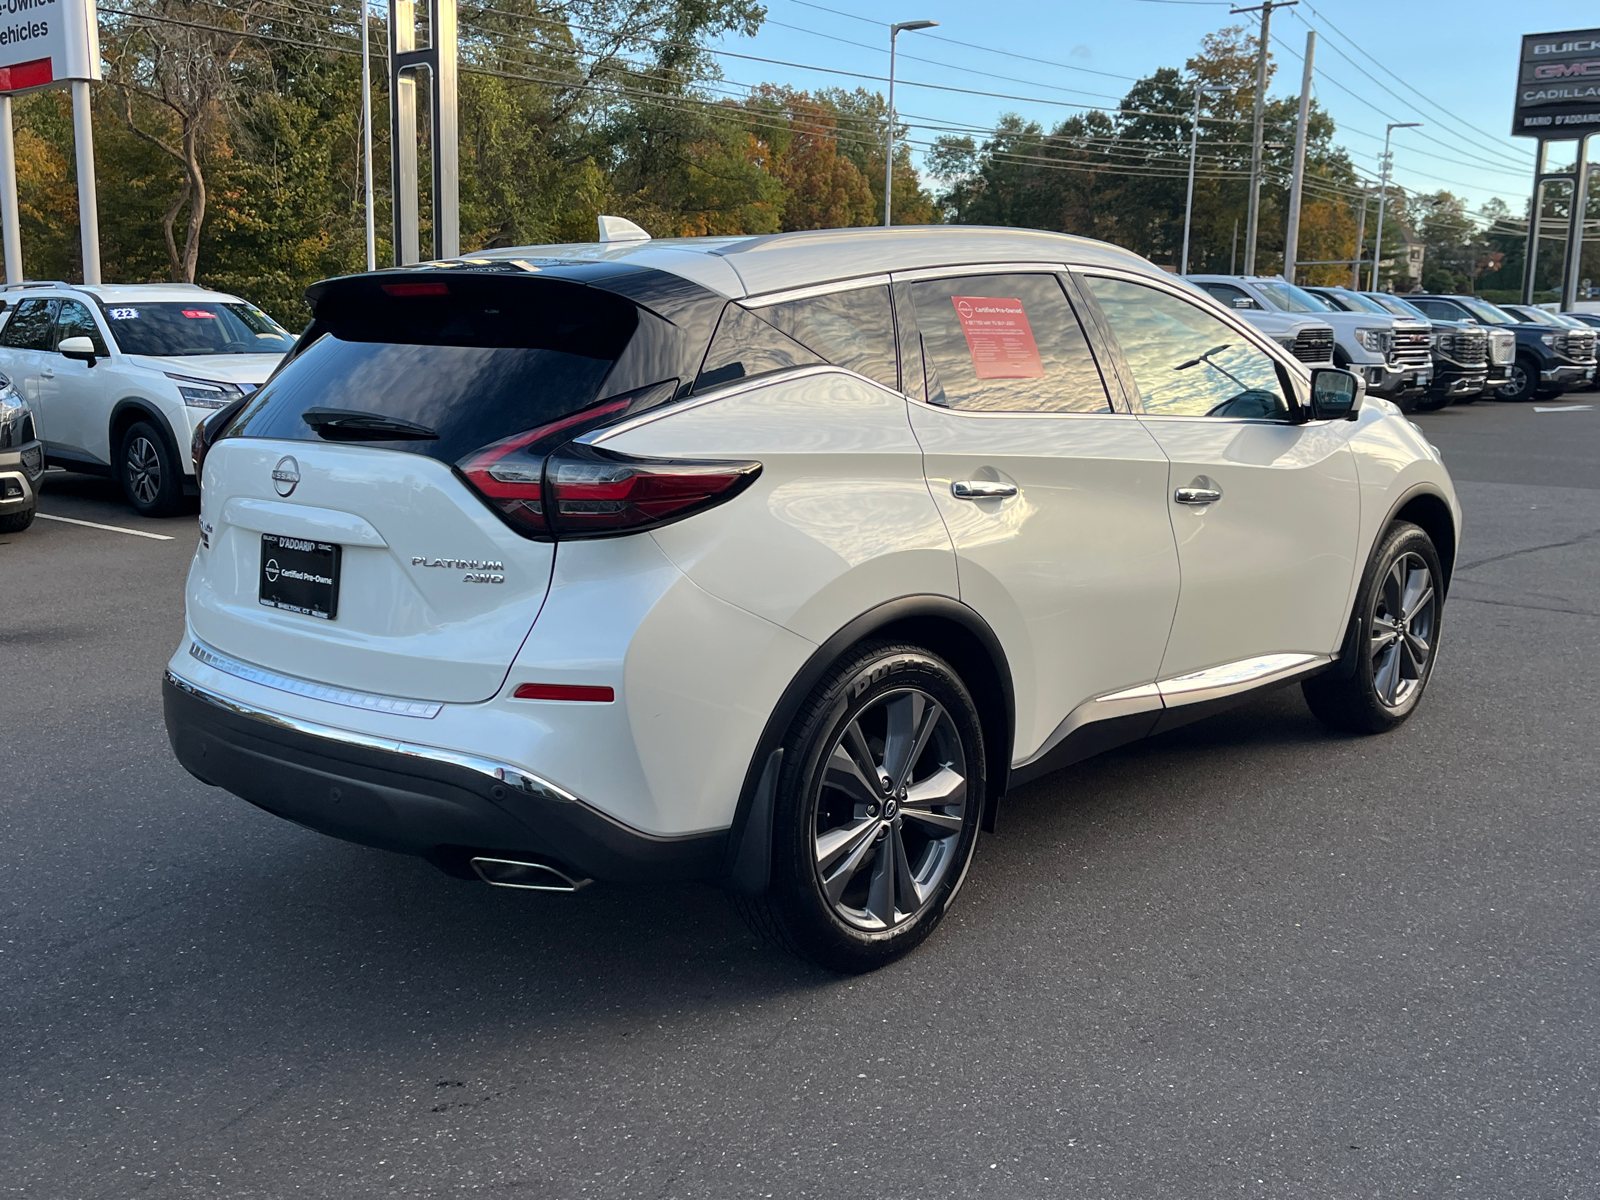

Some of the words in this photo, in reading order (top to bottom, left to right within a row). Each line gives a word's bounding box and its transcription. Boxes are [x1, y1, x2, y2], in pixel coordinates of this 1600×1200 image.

[1535, 62, 1600, 79] GMC
[1523, 87, 1600, 100] CADILLA
[116, 310, 133, 318] 22
[272, 470, 299, 481] NISSAN
[279, 537, 316, 552] D'ADDARIO
[411, 556, 504, 571] PLATINUM
[281, 569, 303, 580] Certified
[463, 573, 504, 584] AWD
